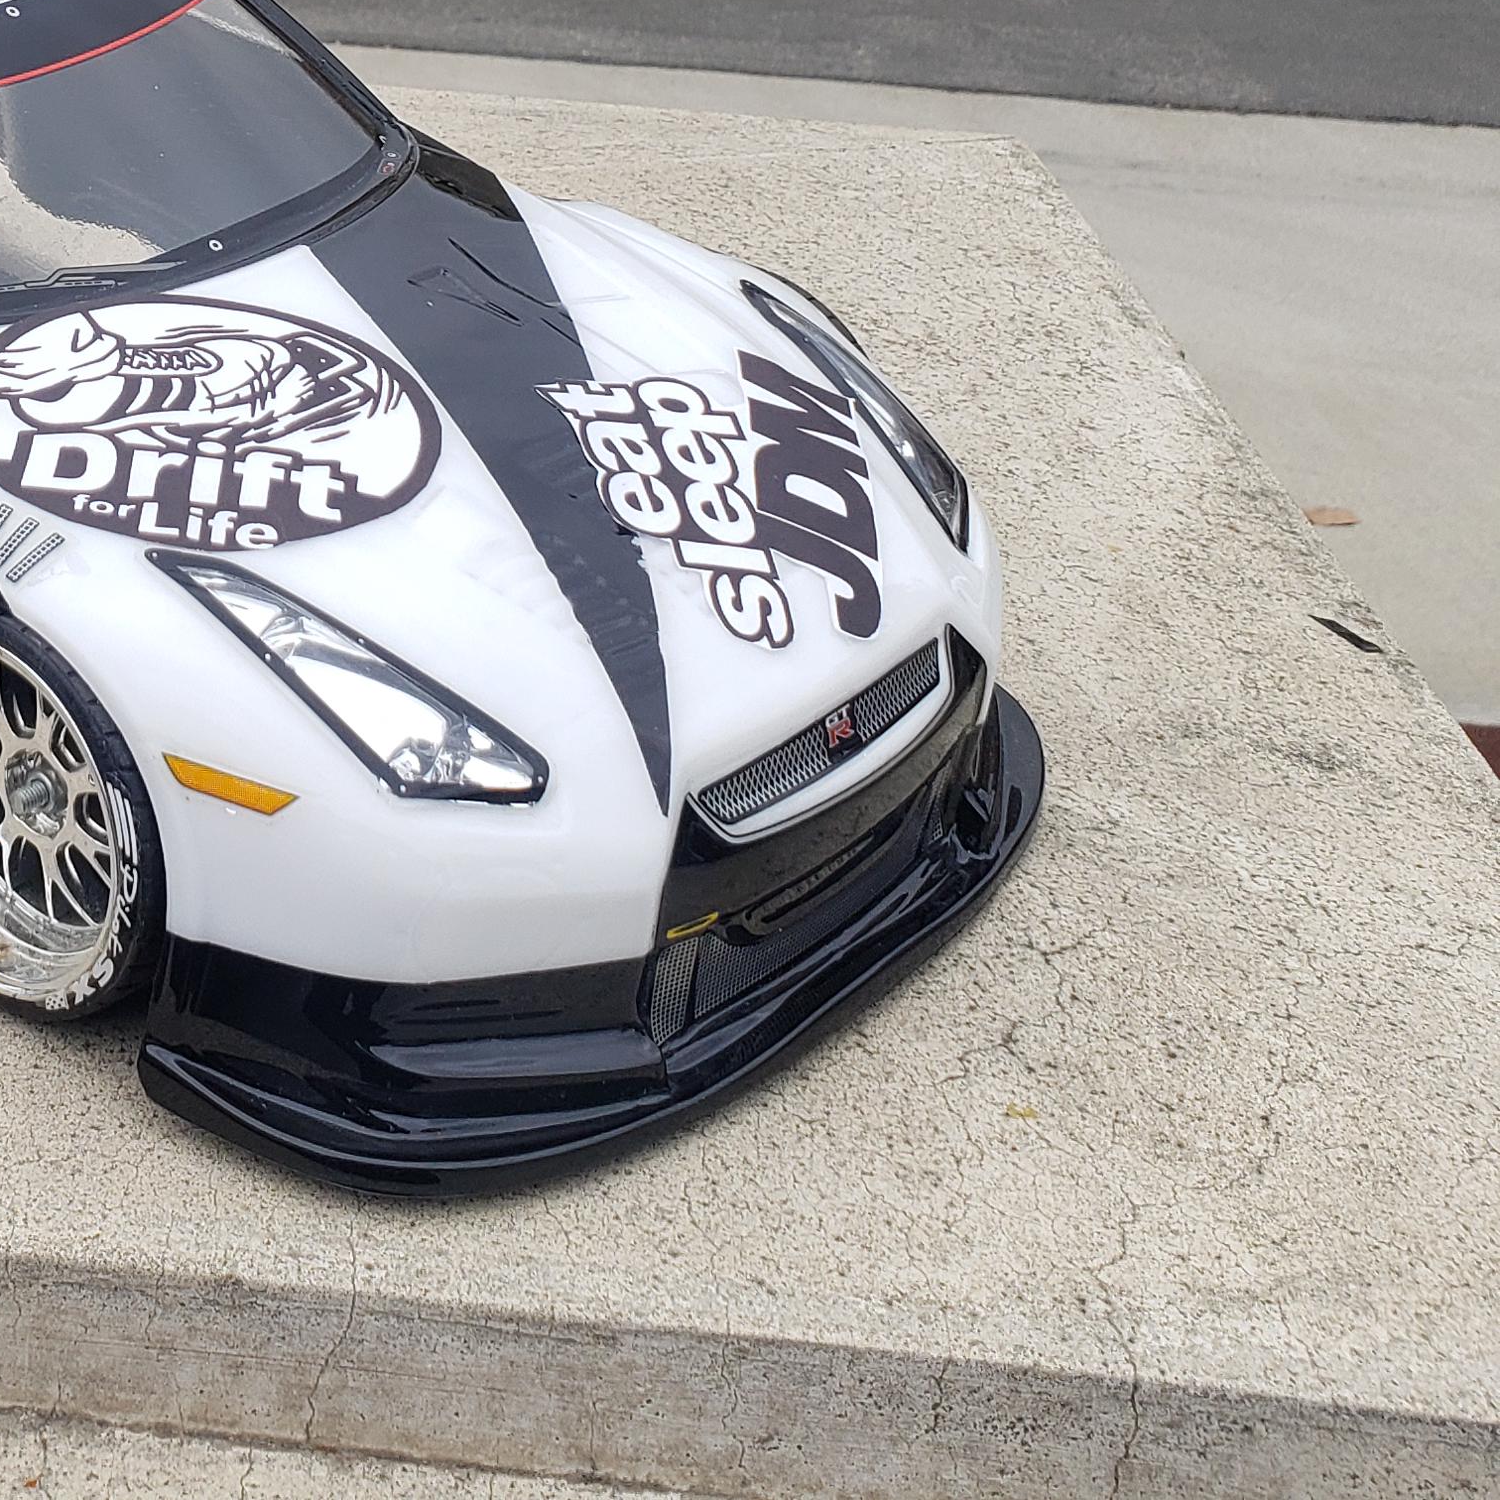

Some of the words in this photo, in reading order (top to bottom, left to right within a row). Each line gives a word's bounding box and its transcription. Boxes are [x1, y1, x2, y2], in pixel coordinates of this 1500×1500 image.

[20, 431, 347, 523] Drift
[545, 380, 683, 536] eat
[636, 378, 793, 646] sleep
[736, 349, 882, 639] JDM
[72, 493, 137, 520] for
[137, 500, 279, 550] Life
[71, 950, 115, 1005] SX
